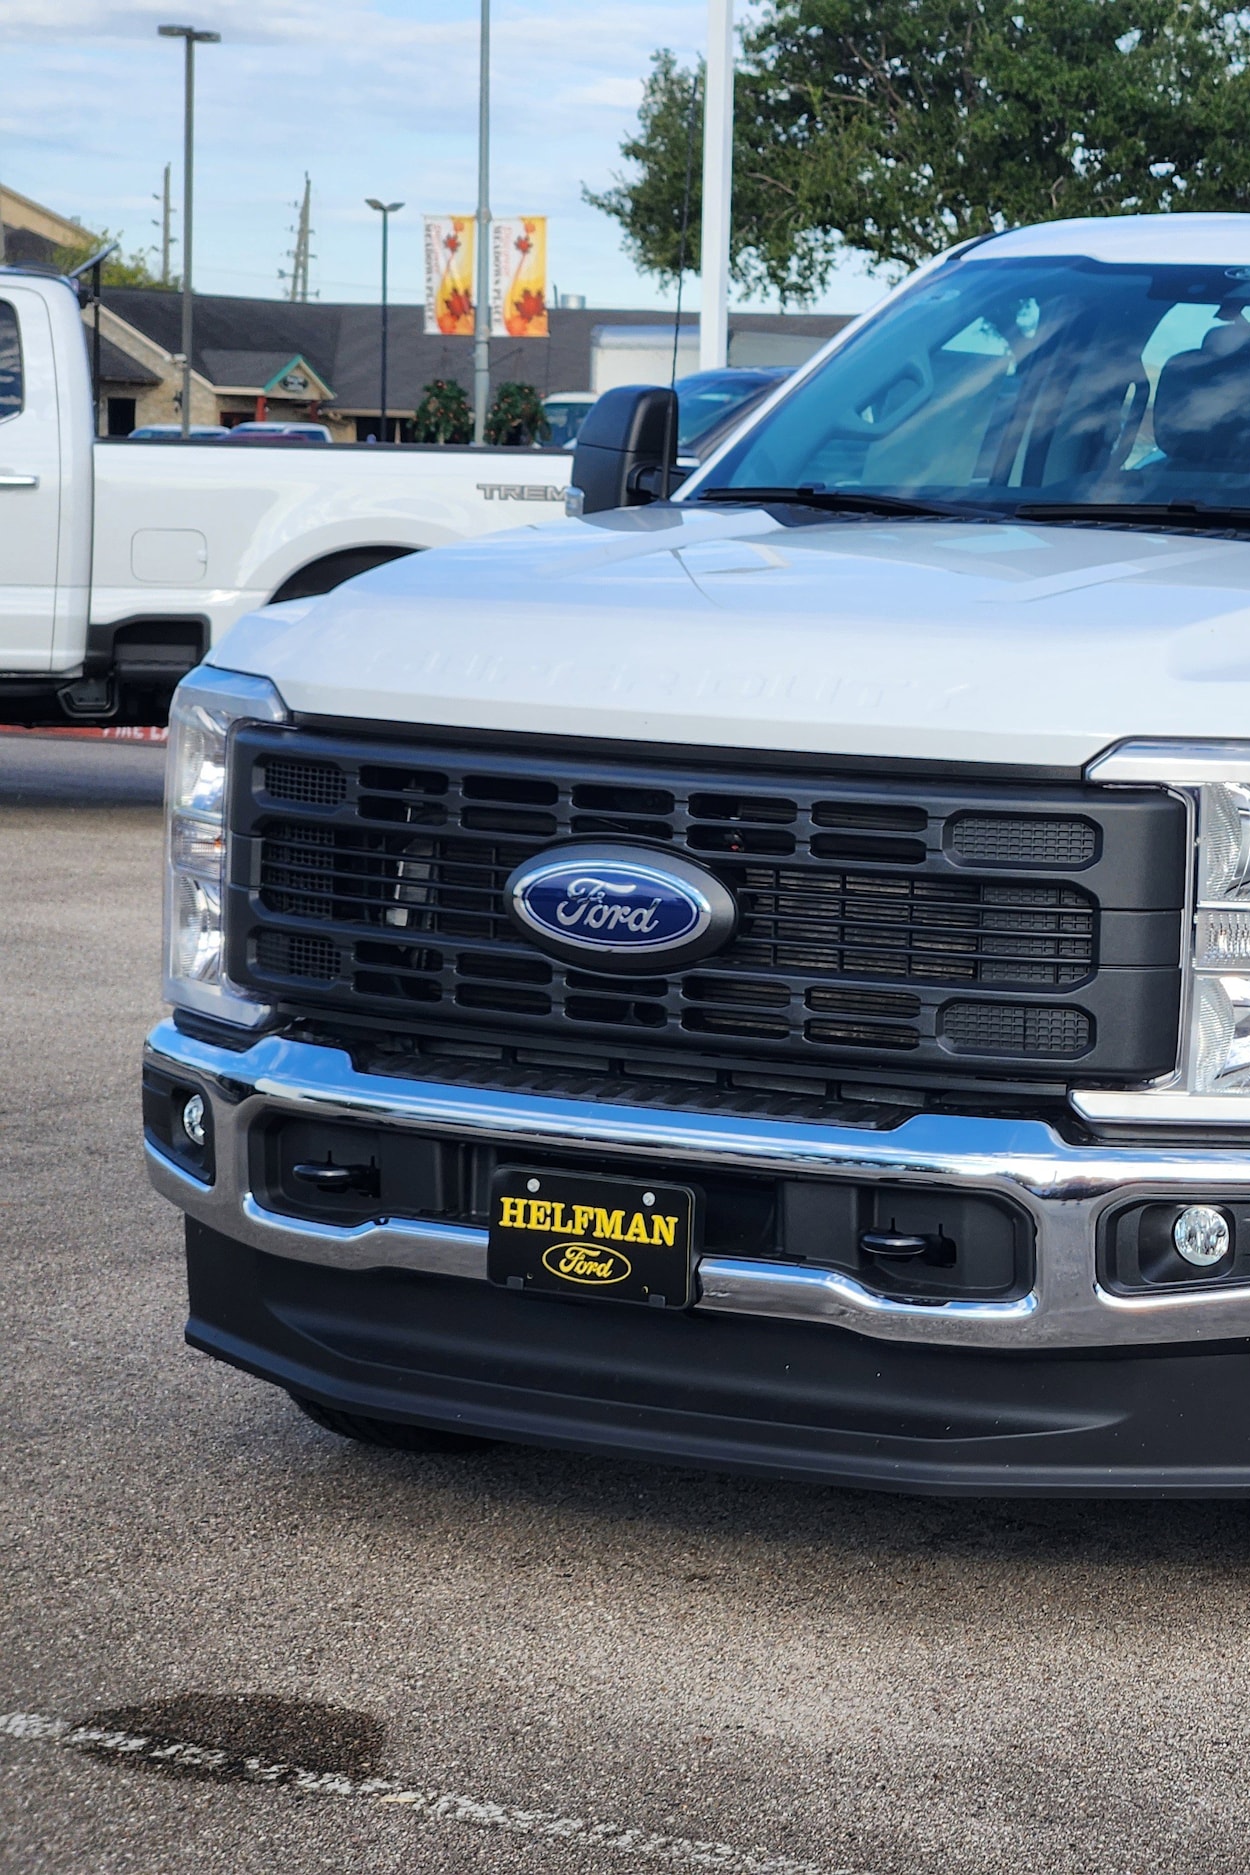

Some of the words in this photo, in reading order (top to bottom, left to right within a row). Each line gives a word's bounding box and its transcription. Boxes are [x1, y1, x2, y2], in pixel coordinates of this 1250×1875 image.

[556, 877, 663, 933] Ford
[498, 1196, 679, 1247] HELFMAN
[558, 1246, 614, 1279] Ford
